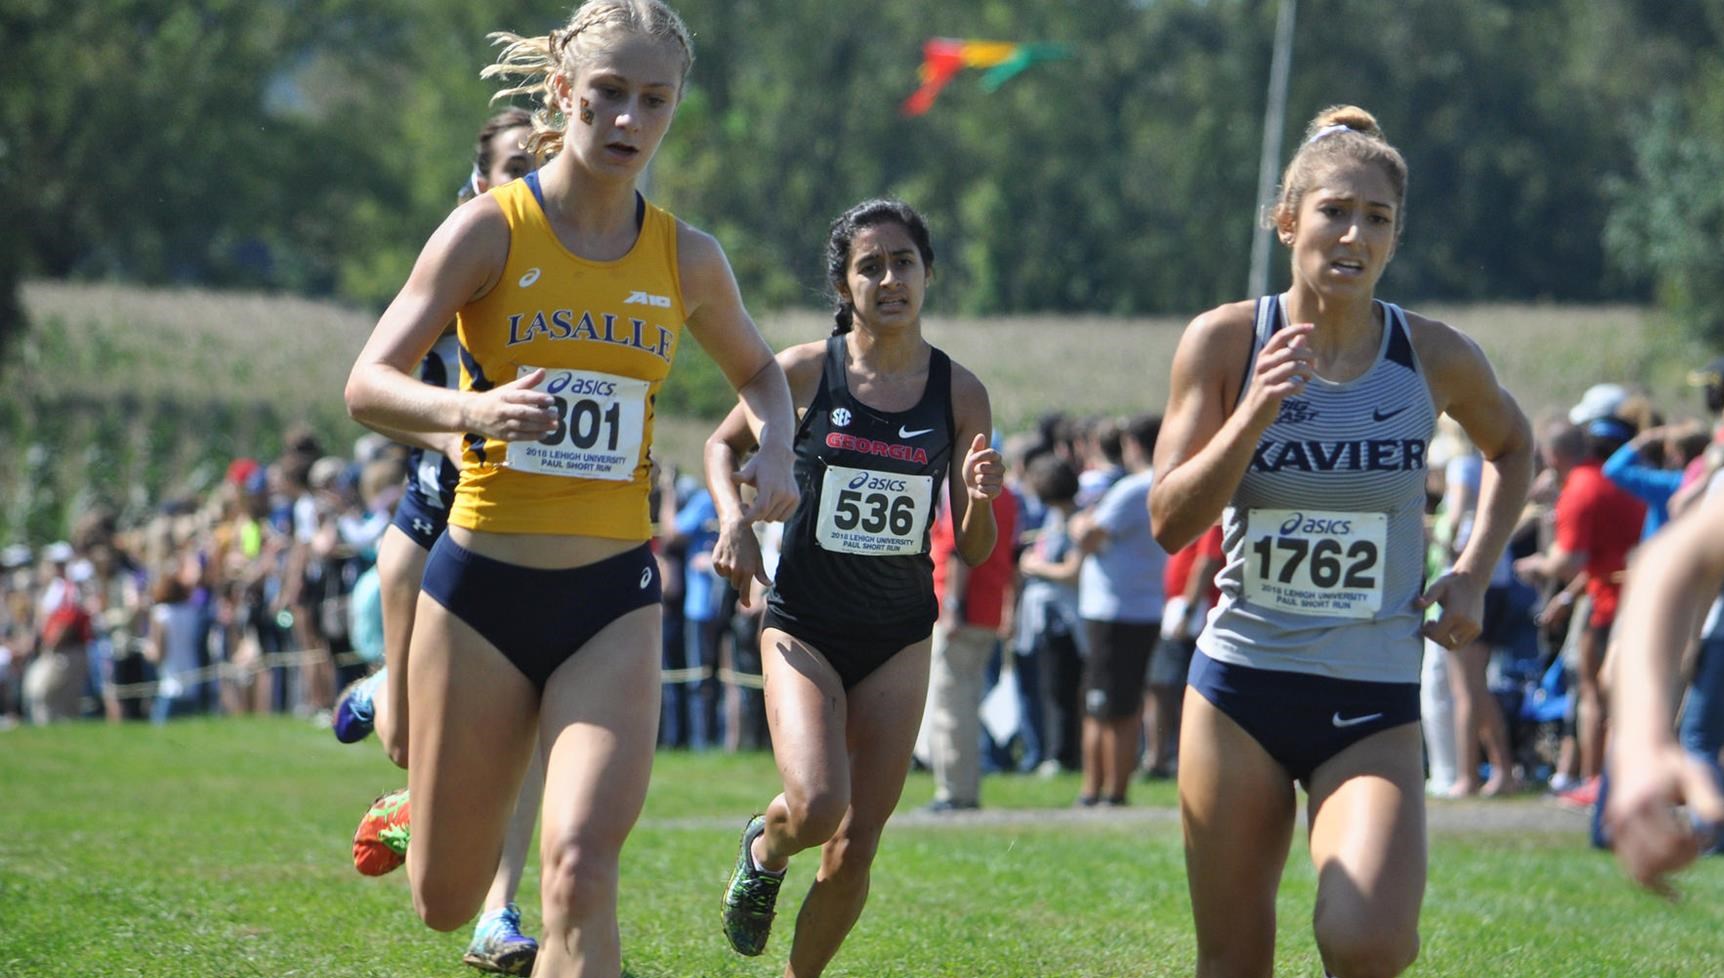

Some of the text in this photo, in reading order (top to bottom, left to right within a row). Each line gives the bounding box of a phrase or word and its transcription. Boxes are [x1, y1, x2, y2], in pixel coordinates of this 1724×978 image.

[571, 378, 617, 397] asics
[831, 407, 852, 426] SEC
[826, 432, 928, 465] GEORGIA
[1251, 439, 1426, 472] XAVIER
[541, 459, 612, 472] PAUL SHORT RUN
[549, 450, 581, 460] LEHIGH
[583, 453, 627, 465] UNIVERSITY
[868, 477, 906, 492] asics
[834, 489, 915, 536] 536
[1302, 518, 1351, 535] asics
[843, 540, 860, 549] PAUL
[849, 534, 875, 543] LEHIGH
[876, 537, 914, 546] UNIVERSITY
[1253, 535, 1378, 589] 1762
[1276, 596, 1298, 606] PAUL
[1301, 600, 1329, 609] SHORT
[1332, 601, 1351, 609] RUN
[1284, 589, 1315, 598] LEHIGH
[1318, 592, 1368, 601] UNIVERSITY
